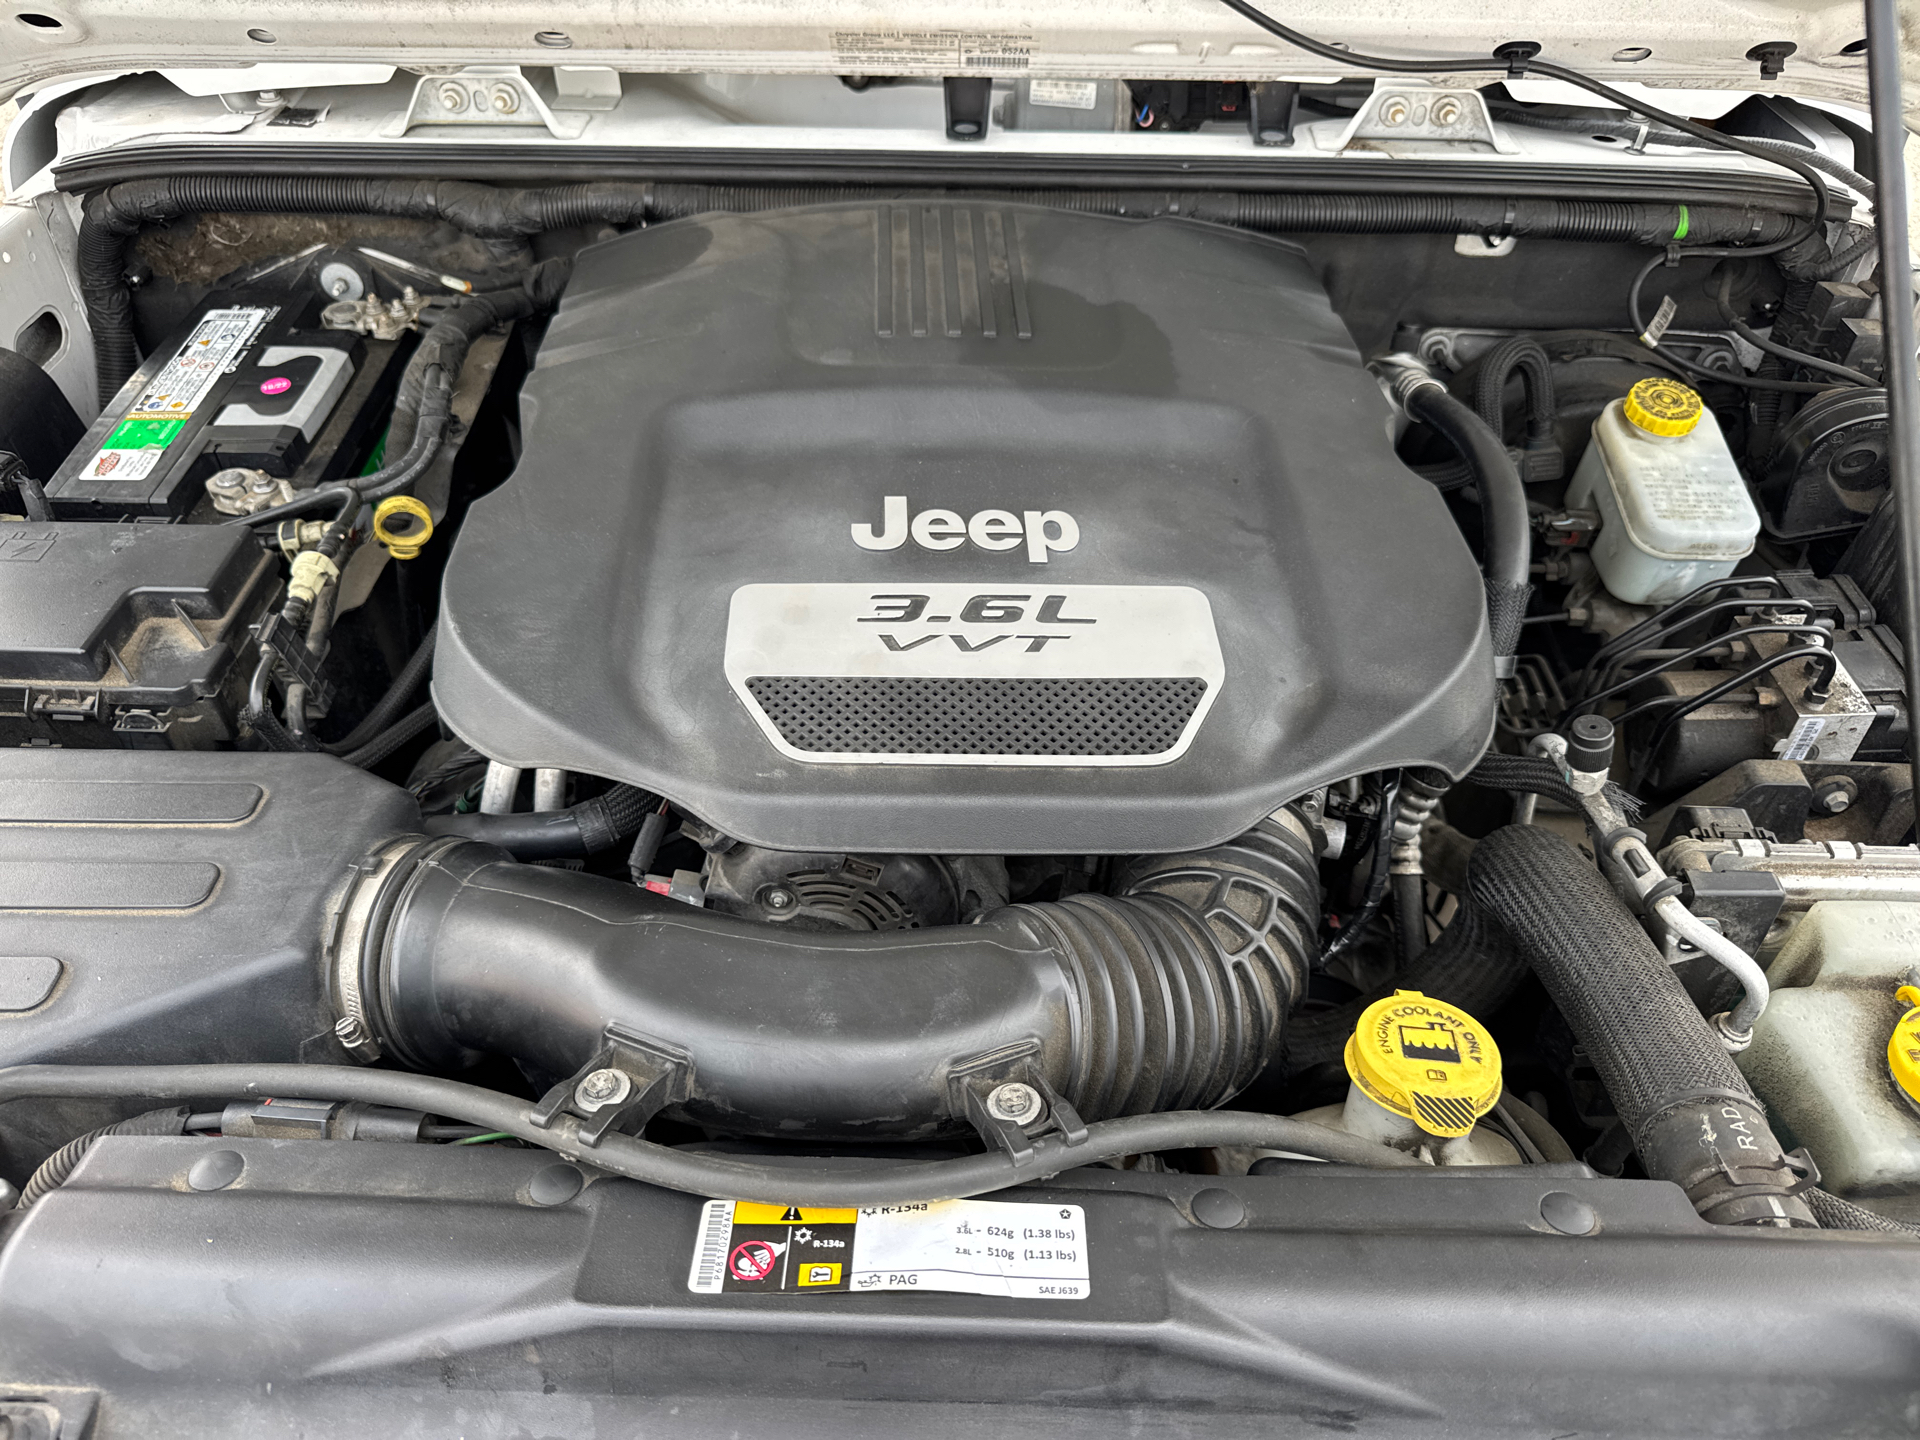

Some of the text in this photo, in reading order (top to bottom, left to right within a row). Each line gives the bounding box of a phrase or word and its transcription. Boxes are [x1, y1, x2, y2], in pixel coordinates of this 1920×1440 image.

[851, 496, 1080, 564] Jeep
[856, 594, 1097, 625] 3.6L
[877, 634, 1072, 653] VVT
[1377, 1006, 1483, 1065] ENGINE COOLANT ONLY
[1721, 1106, 1759, 1151] RAD
[956, 1226, 973, 1235] 3.6L
[987, 1226, 1014, 1239] 624g
[1023, 1228, 1052, 1240] (1.38
[1055, 1229, 1076, 1241] lbs)
[713, 1210, 733, 1280] P68170298AA
[812, 1239, 846, 1248] R-134a
[955, 1246, 972, 1255] 2.8L
[987, 1247, 1015, 1260] 510g
[1024, 1249, 1053, 1261] (1.13
[1056, 1250, 1077, 1262] lbs)
[889, 1274, 918, 1286] PAG
[1038, 1286, 1079, 1295] SAE J639
